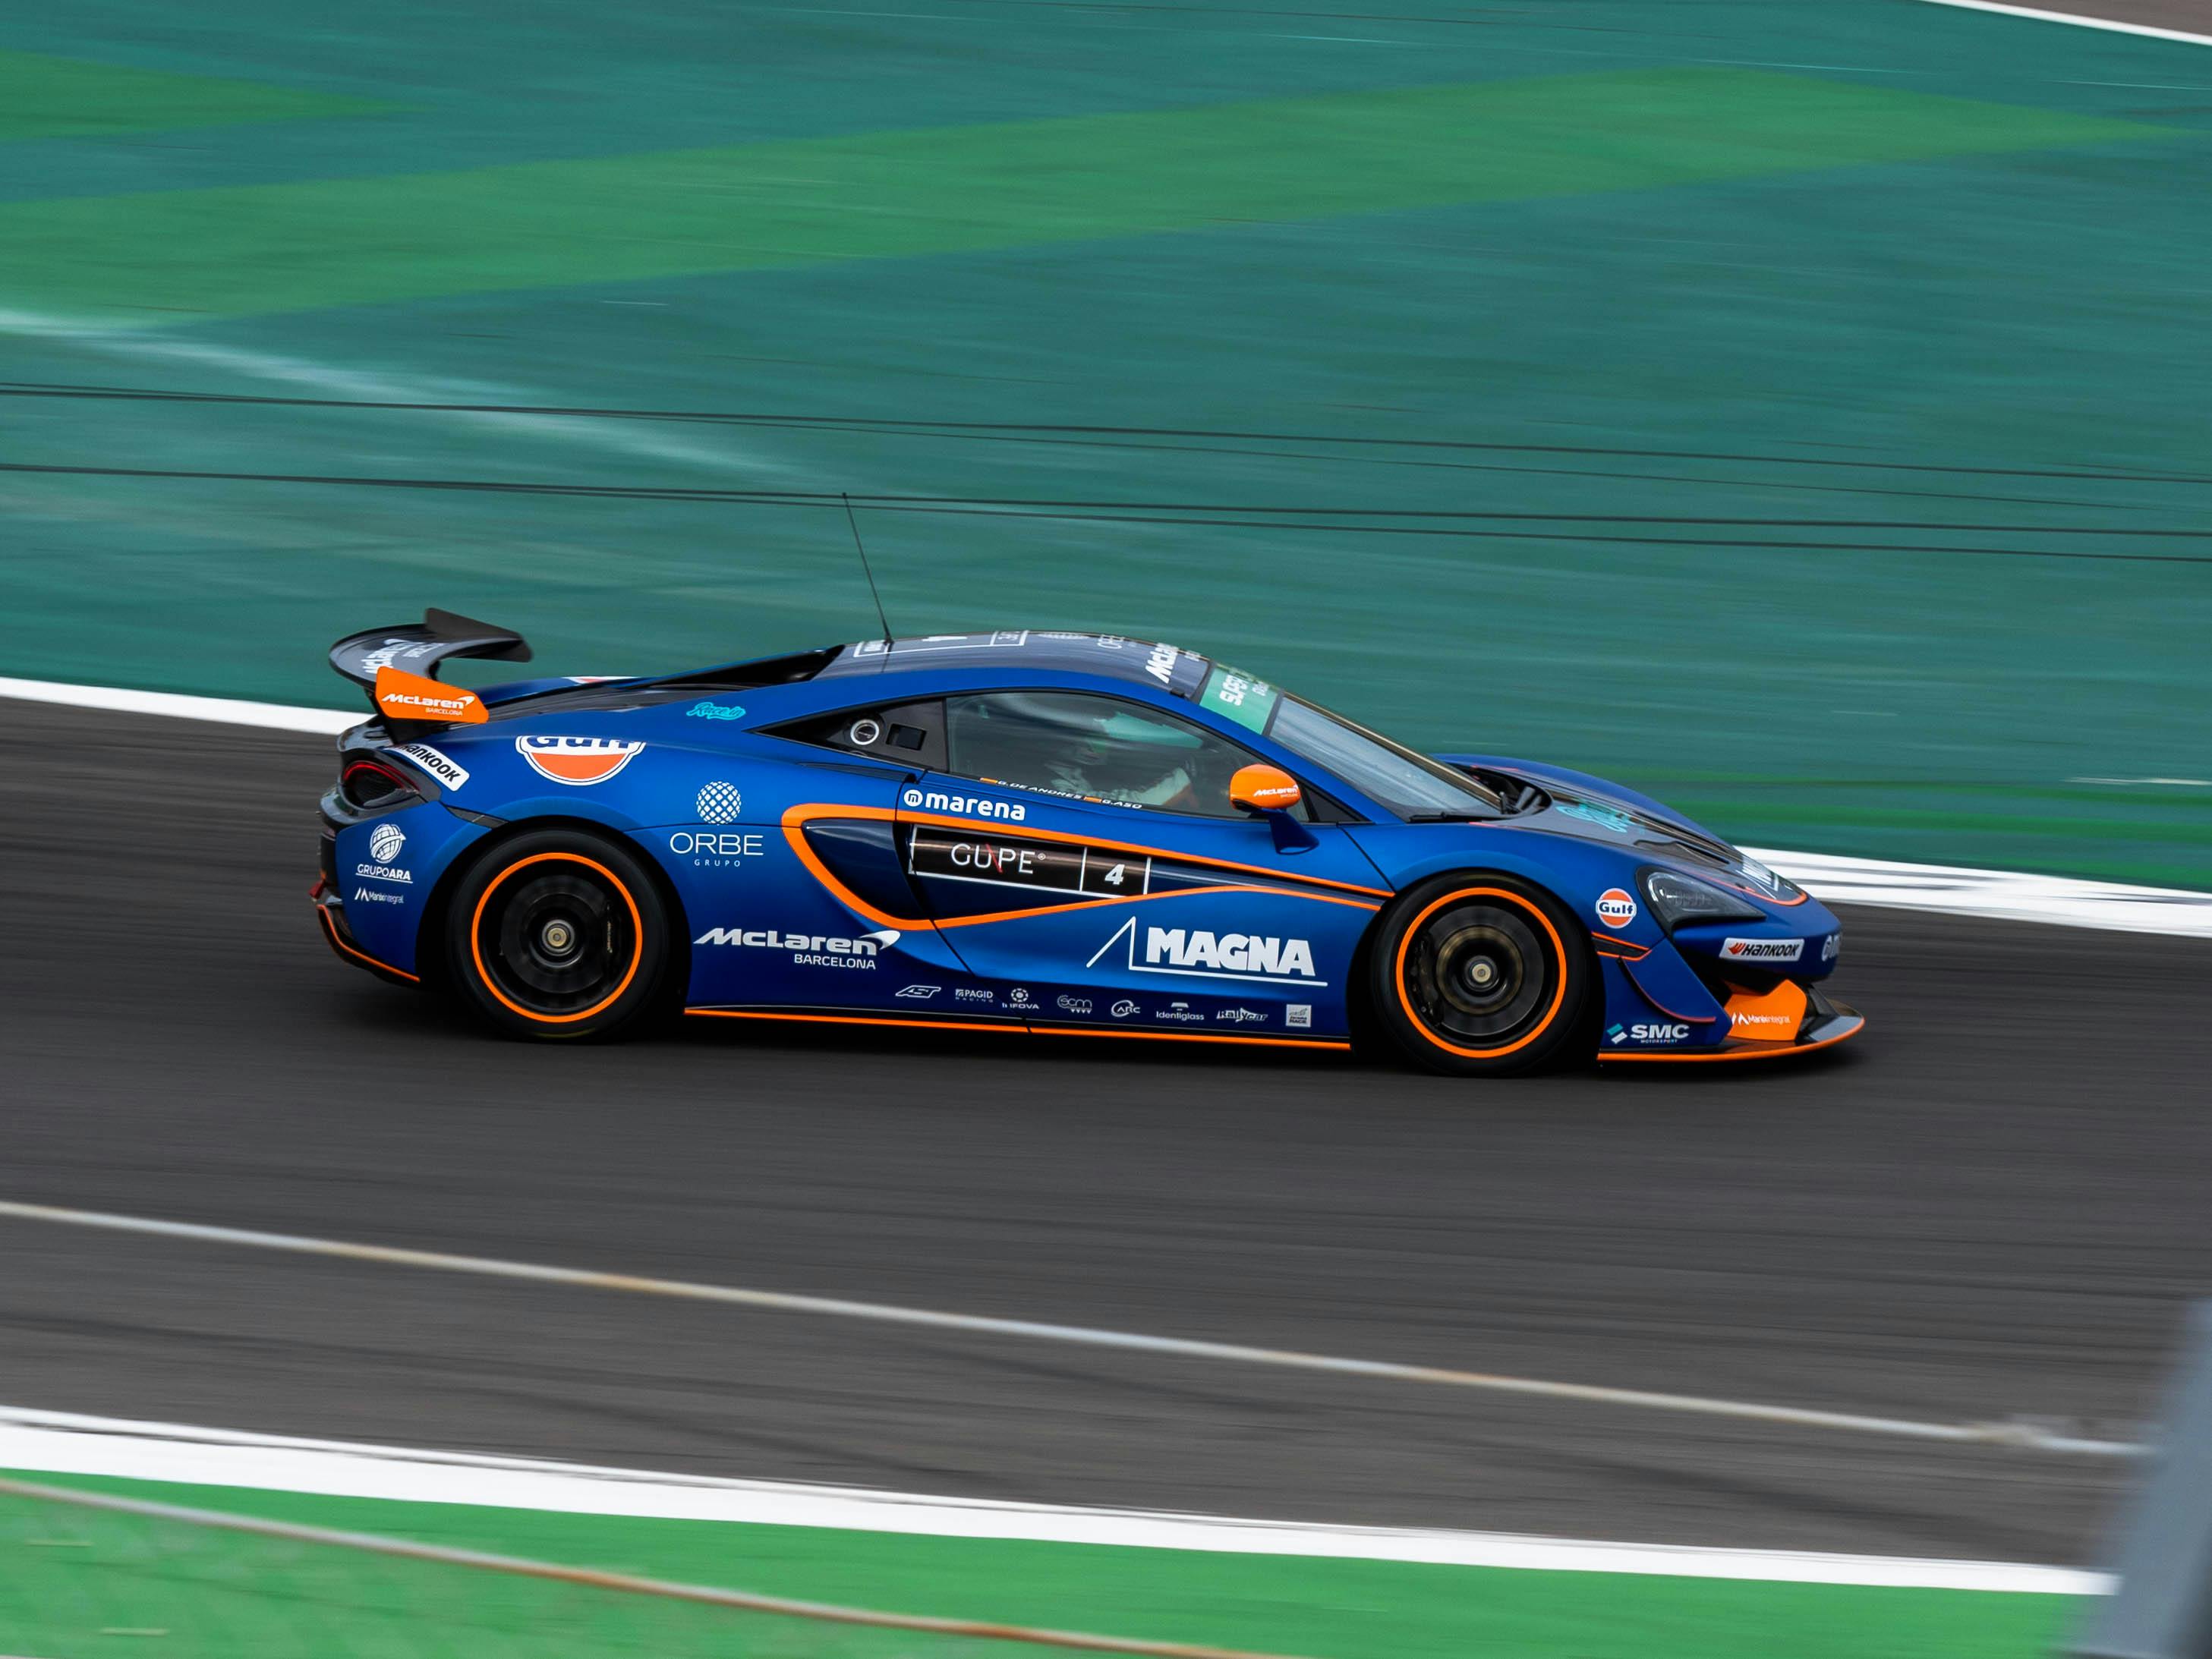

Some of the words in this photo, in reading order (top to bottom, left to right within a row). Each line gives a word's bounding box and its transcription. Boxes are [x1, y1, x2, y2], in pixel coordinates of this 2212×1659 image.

[382, 694, 465, 710] McLaren
[425, 707, 464, 716] BARCELONA
[925, 792, 1026, 821] marena
[670, 832, 764, 856] ORBE
[694, 858, 741, 867] GRUPO
[357, 864, 411, 881] GRUPOARA
[1104, 864, 1126, 886] 4
[1599, 902, 1634, 914] Gulf
[693, 927, 877, 955] McLaren
[1145, 927, 1316, 977] MAGNA
[794, 953, 876, 970] BARCELONA
[965, 989, 994, 999] PAGID
[1155, 1010, 1205, 1022] Identiglass
[1631, 1024, 1690, 1039] SMC
